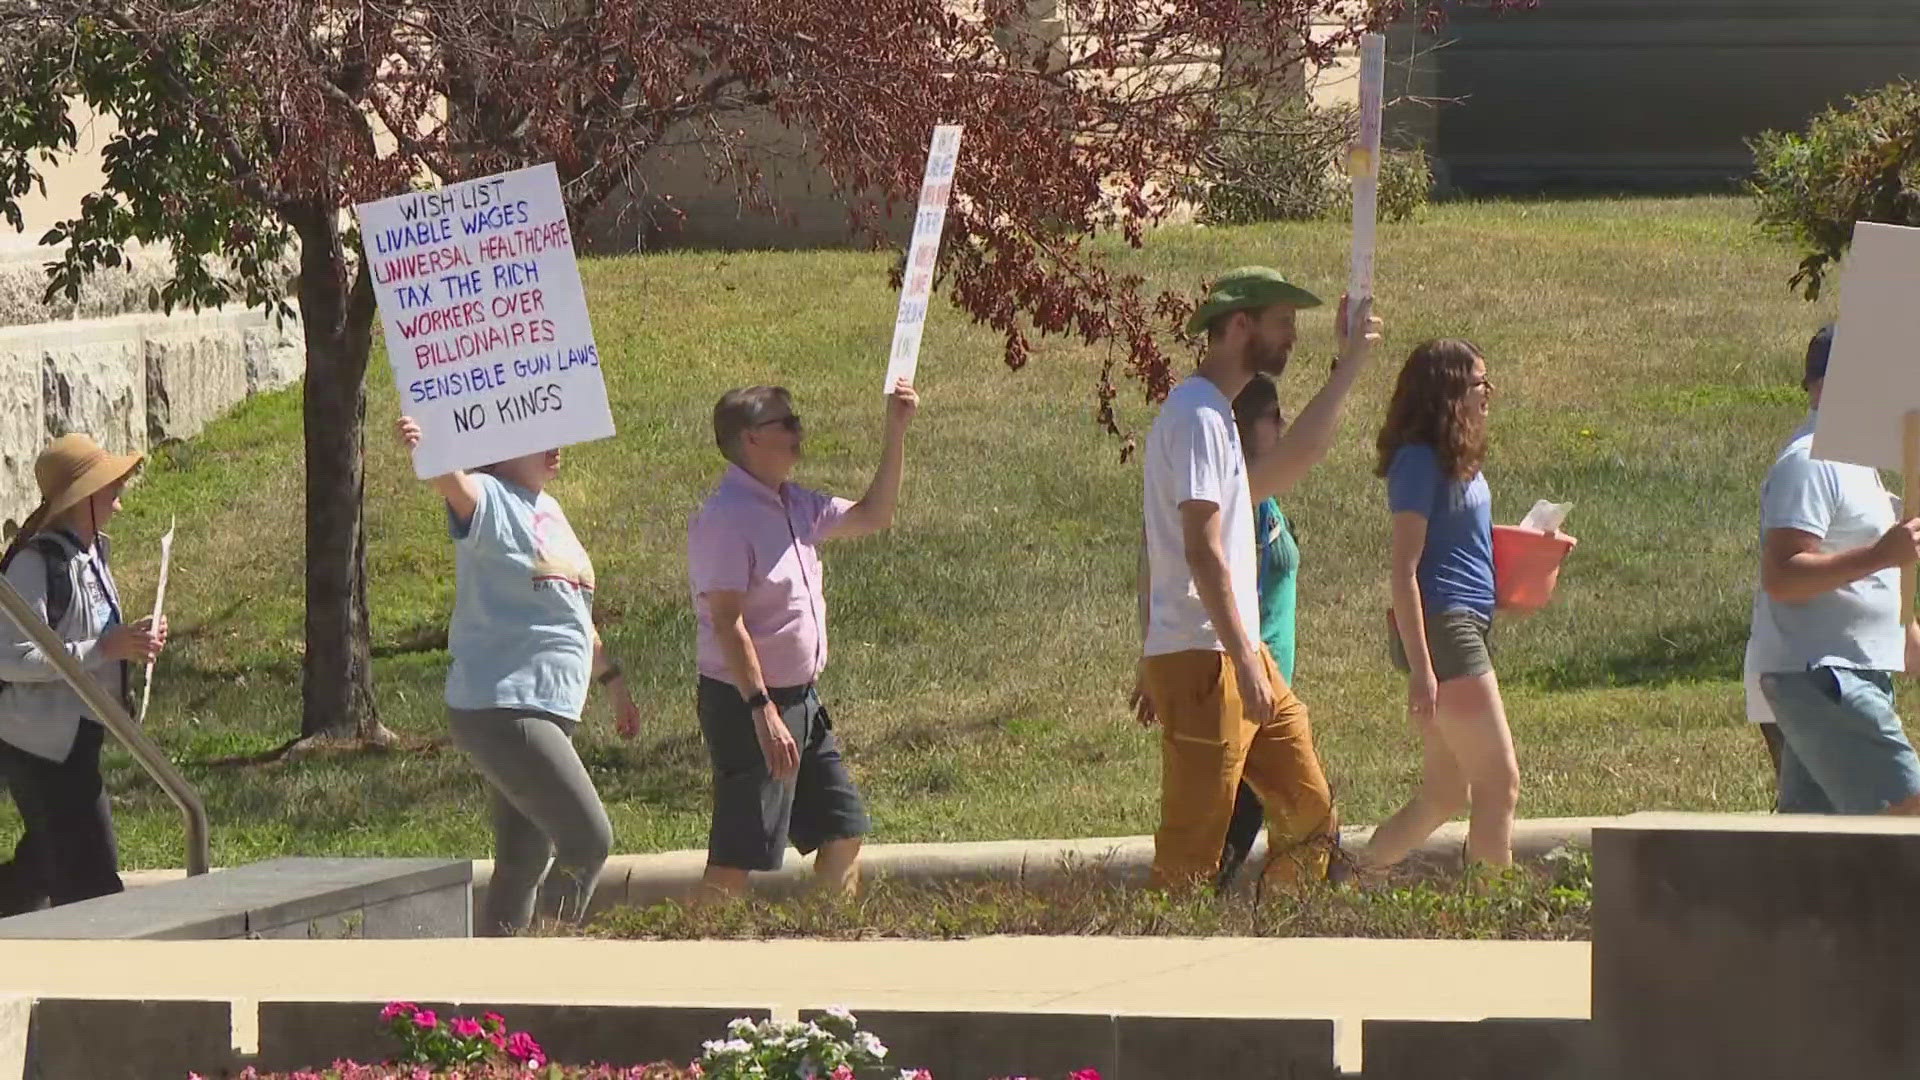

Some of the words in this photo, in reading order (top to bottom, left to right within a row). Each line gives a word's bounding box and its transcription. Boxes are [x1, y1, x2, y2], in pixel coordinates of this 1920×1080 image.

[401, 192, 455, 221] WISH
[462, 179, 505, 209] LIST
[375, 249, 472, 284] UNIVERSAL
[479, 219, 569, 261] HEALTHCARE
[376, 219, 452, 254] LIVABLE
[461, 201, 529, 234] WAGES
[394, 282, 433, 310] TAX
[440, 270, 482, 299] THE
[494, 261, 539, 286] RICH
[396, 302, 486, 339] WORKERS
[491, 289, 545, 318] OVER
[415, 319, 556, 369] BILLIONAIRES
[409, 364, 505, 403] SENSIBLE
[514, 357, 552, 378] GUN
[558, 345, 599, 372] LAWS
[453, 404, 486, 433] NO
[496, 384, 563, 425] KINGS
